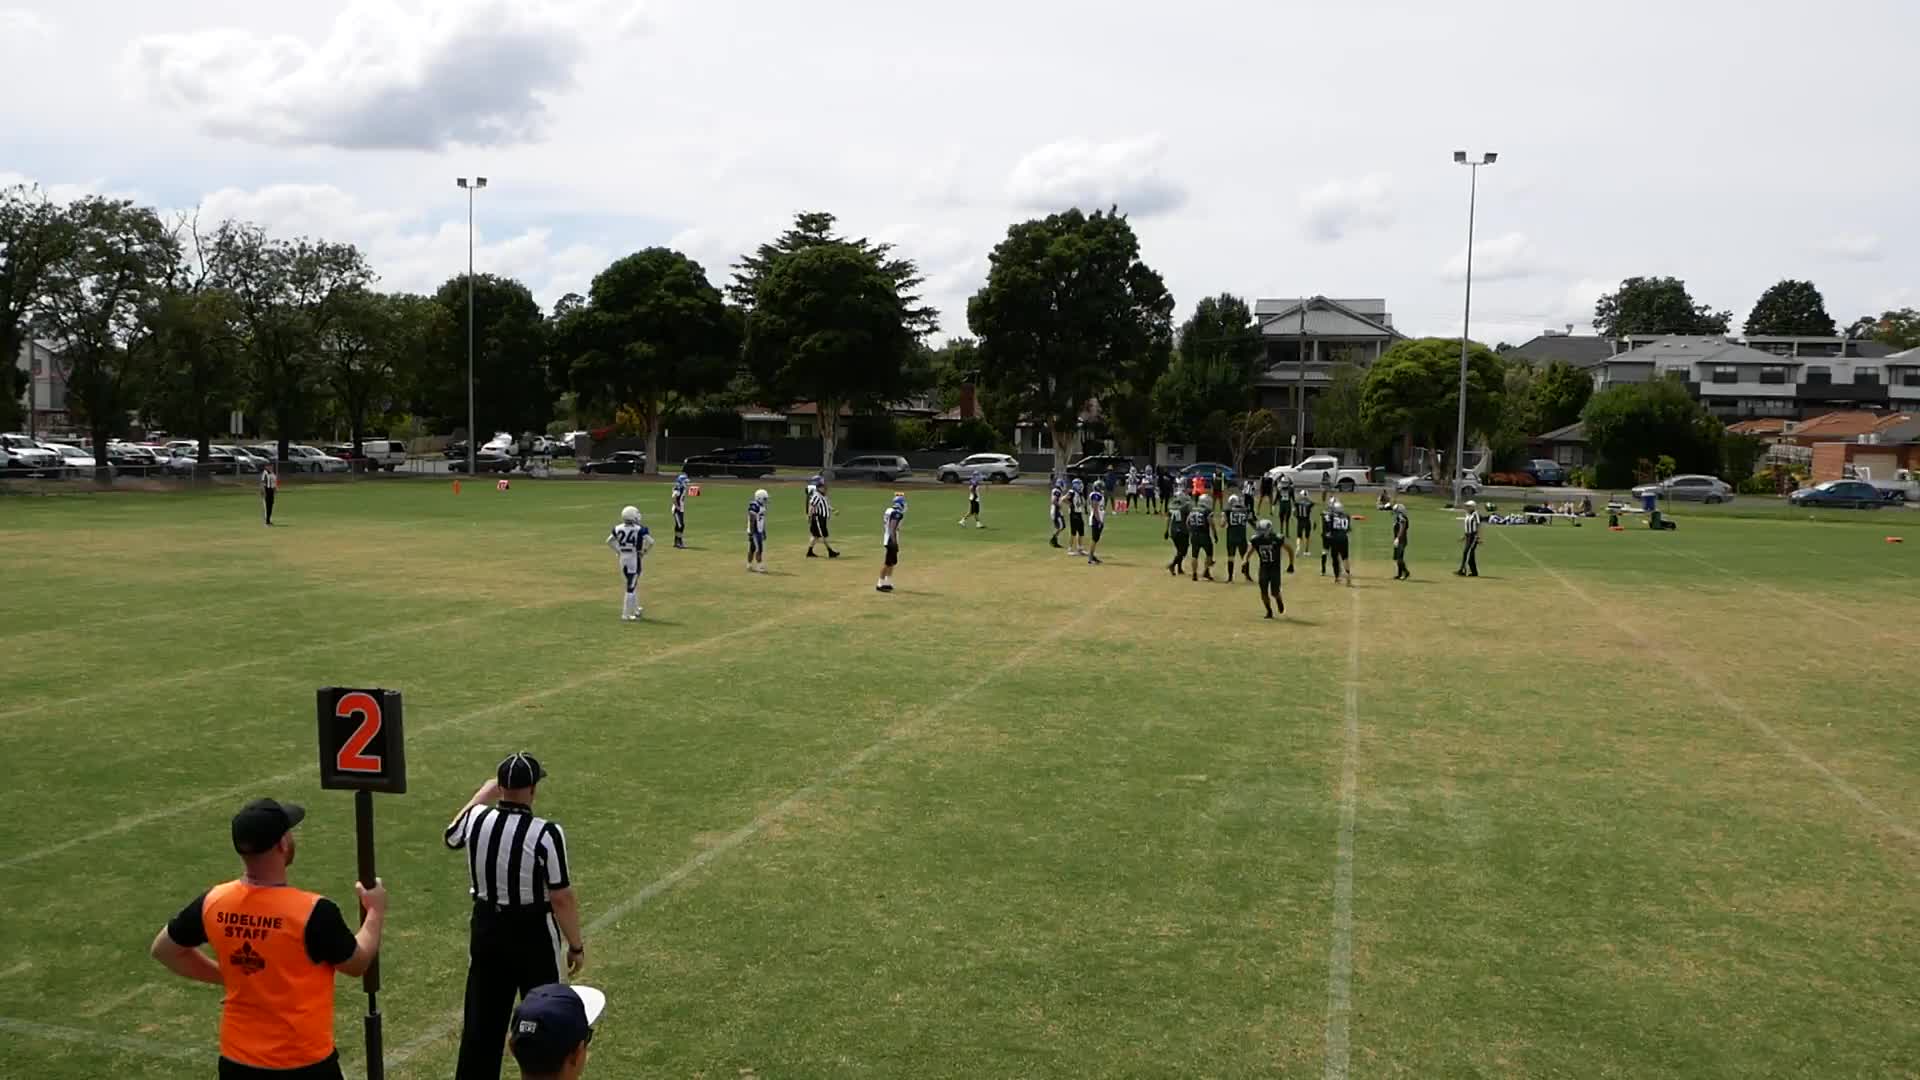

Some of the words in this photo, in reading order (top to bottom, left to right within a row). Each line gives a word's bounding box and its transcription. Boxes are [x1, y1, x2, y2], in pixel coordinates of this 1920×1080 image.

[617, 530, 636, 547] 24
[336, 692, 382, 773] 2
[216, 911, 283, 929] SIDELINE
[224, 926, 269, 941] STAFF
